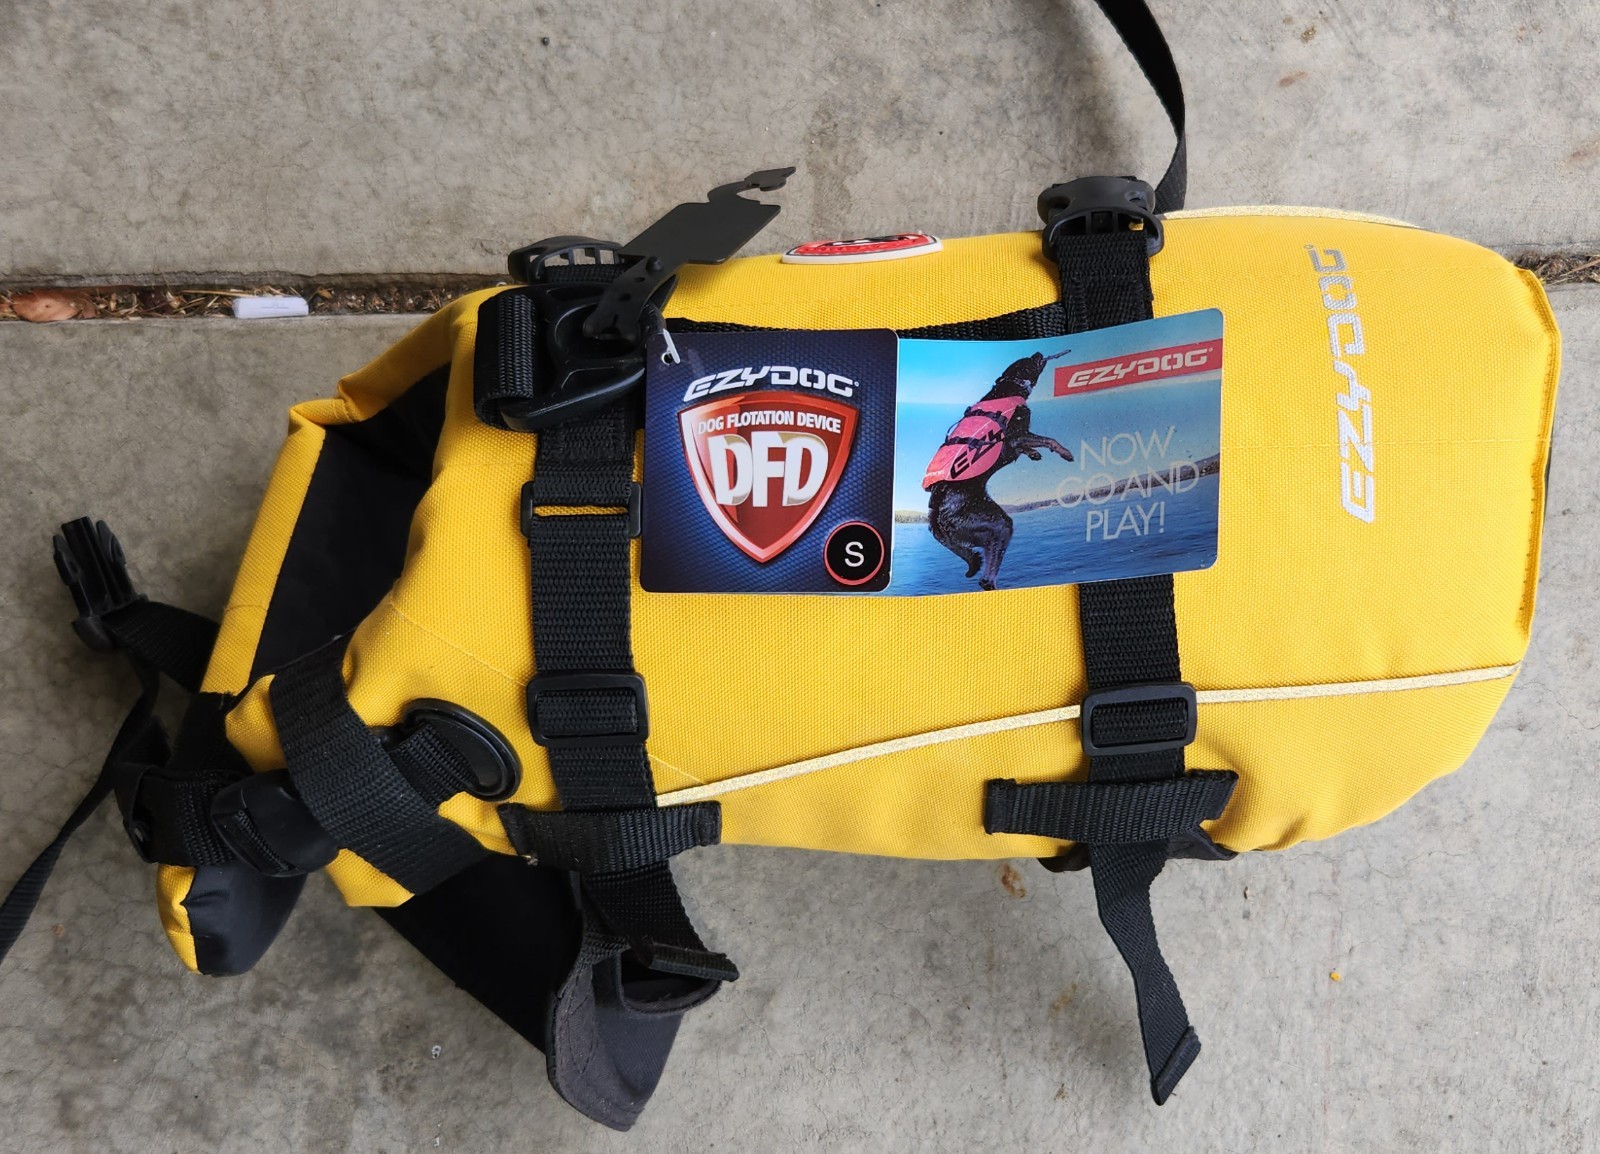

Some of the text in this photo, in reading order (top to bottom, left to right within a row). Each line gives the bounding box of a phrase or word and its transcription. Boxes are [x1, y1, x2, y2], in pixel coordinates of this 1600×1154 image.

[683, 366, 859, 402] EZYDOG
[1067, 348, 1212, 388] EZYDOG
[1308, 245, 1374, 524] EZYDOG
[697, 410, 841, 435] DOG FLOTATION DEVICE
[706, 430, 829, 507] DFD
[1079, 425, 1175, 471] NOW
[1057, 460, 1200, 509] GO AND
[1085, 501, 1166, 542] PLAY!
[844, 541, 865, 567] S
